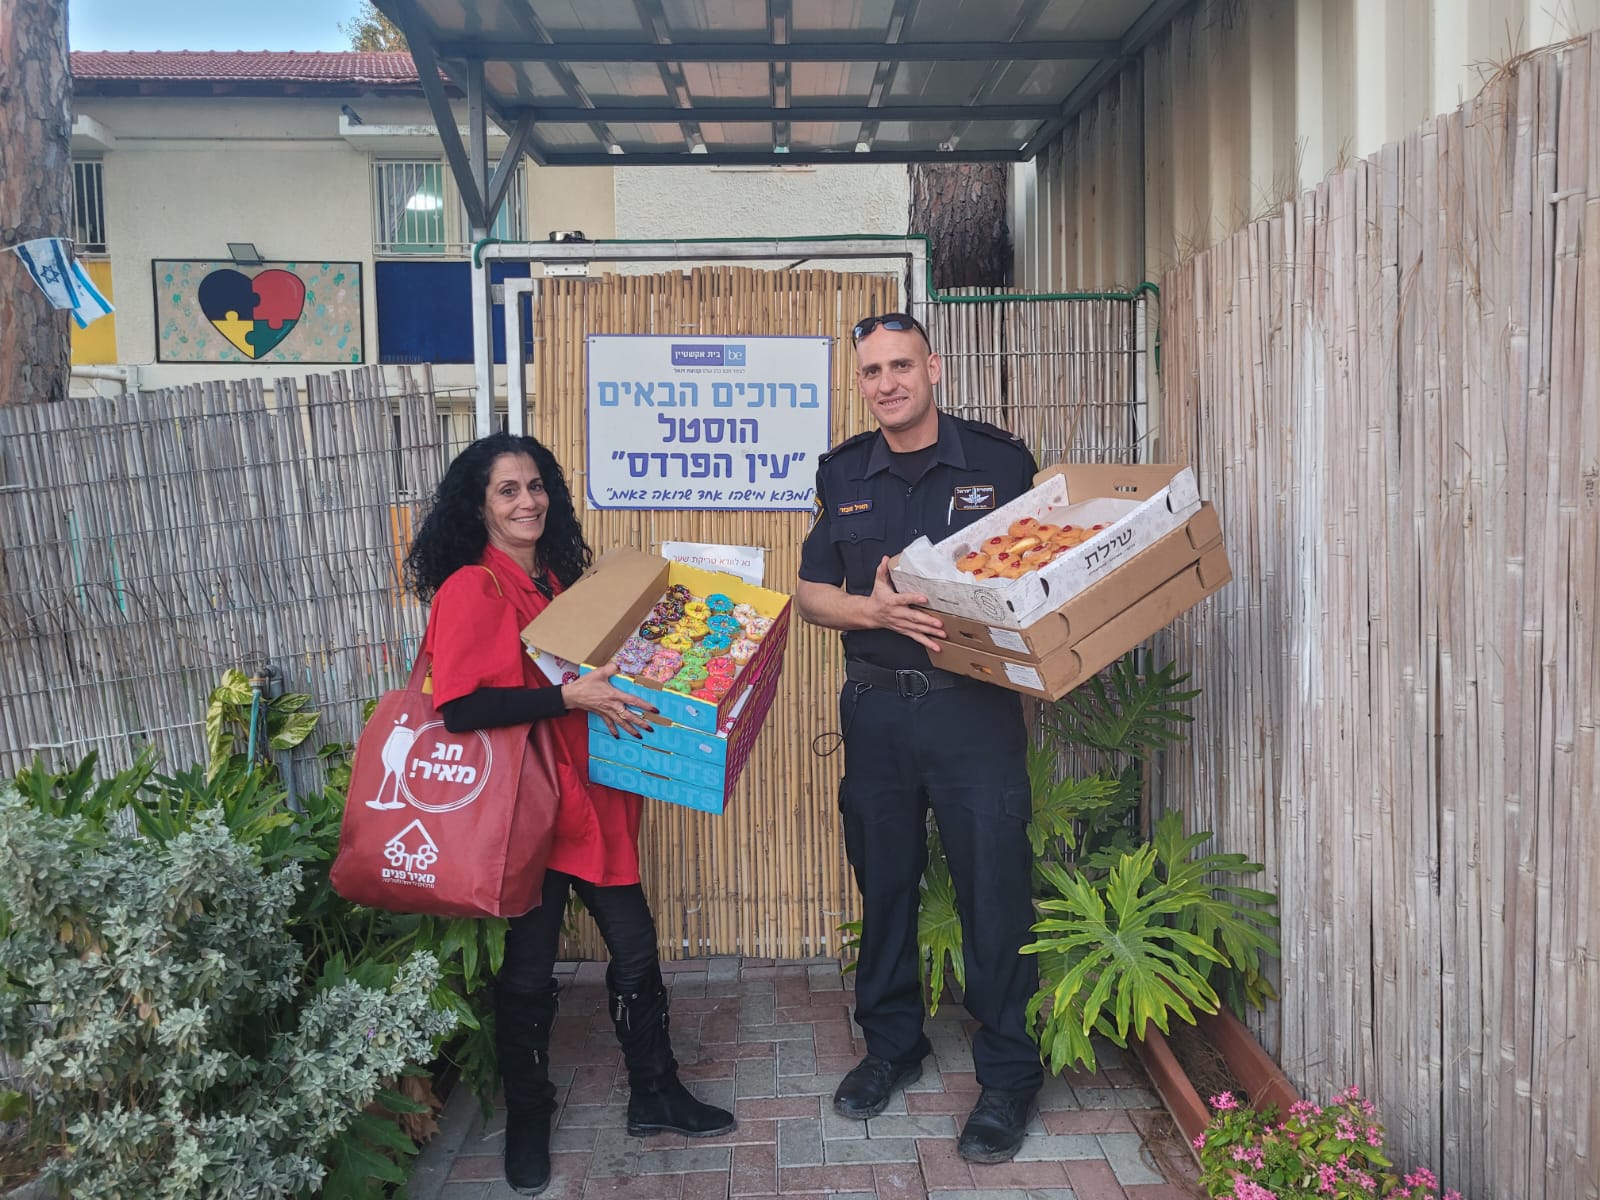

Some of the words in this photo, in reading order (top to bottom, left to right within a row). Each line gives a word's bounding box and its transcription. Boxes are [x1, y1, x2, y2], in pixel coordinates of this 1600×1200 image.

[675, 351, 705, 360] אקשטיין
[728, 349, 743, 360] be
[597, 381, 699, 407] הבאים
[711, 382, 820, 409] ברוכים
[657, 413, 759, 443] הוסטל
[652, 488, 693, 501] שרואה
[697, 489, 723, 501] אחד
[728, 490, 766, 501] מישהו
[1084, 528, 1132, 570] שילת
[430, 741, 464, 761] חג
[409, 758, 477, 785] מאיר!
[599, 737, 720, 787] DONUTS
[597, 763, 719, 810] DONUTS
[382, 868, 406, 880] פנים
[407, 871, 436, 884] מאיר
